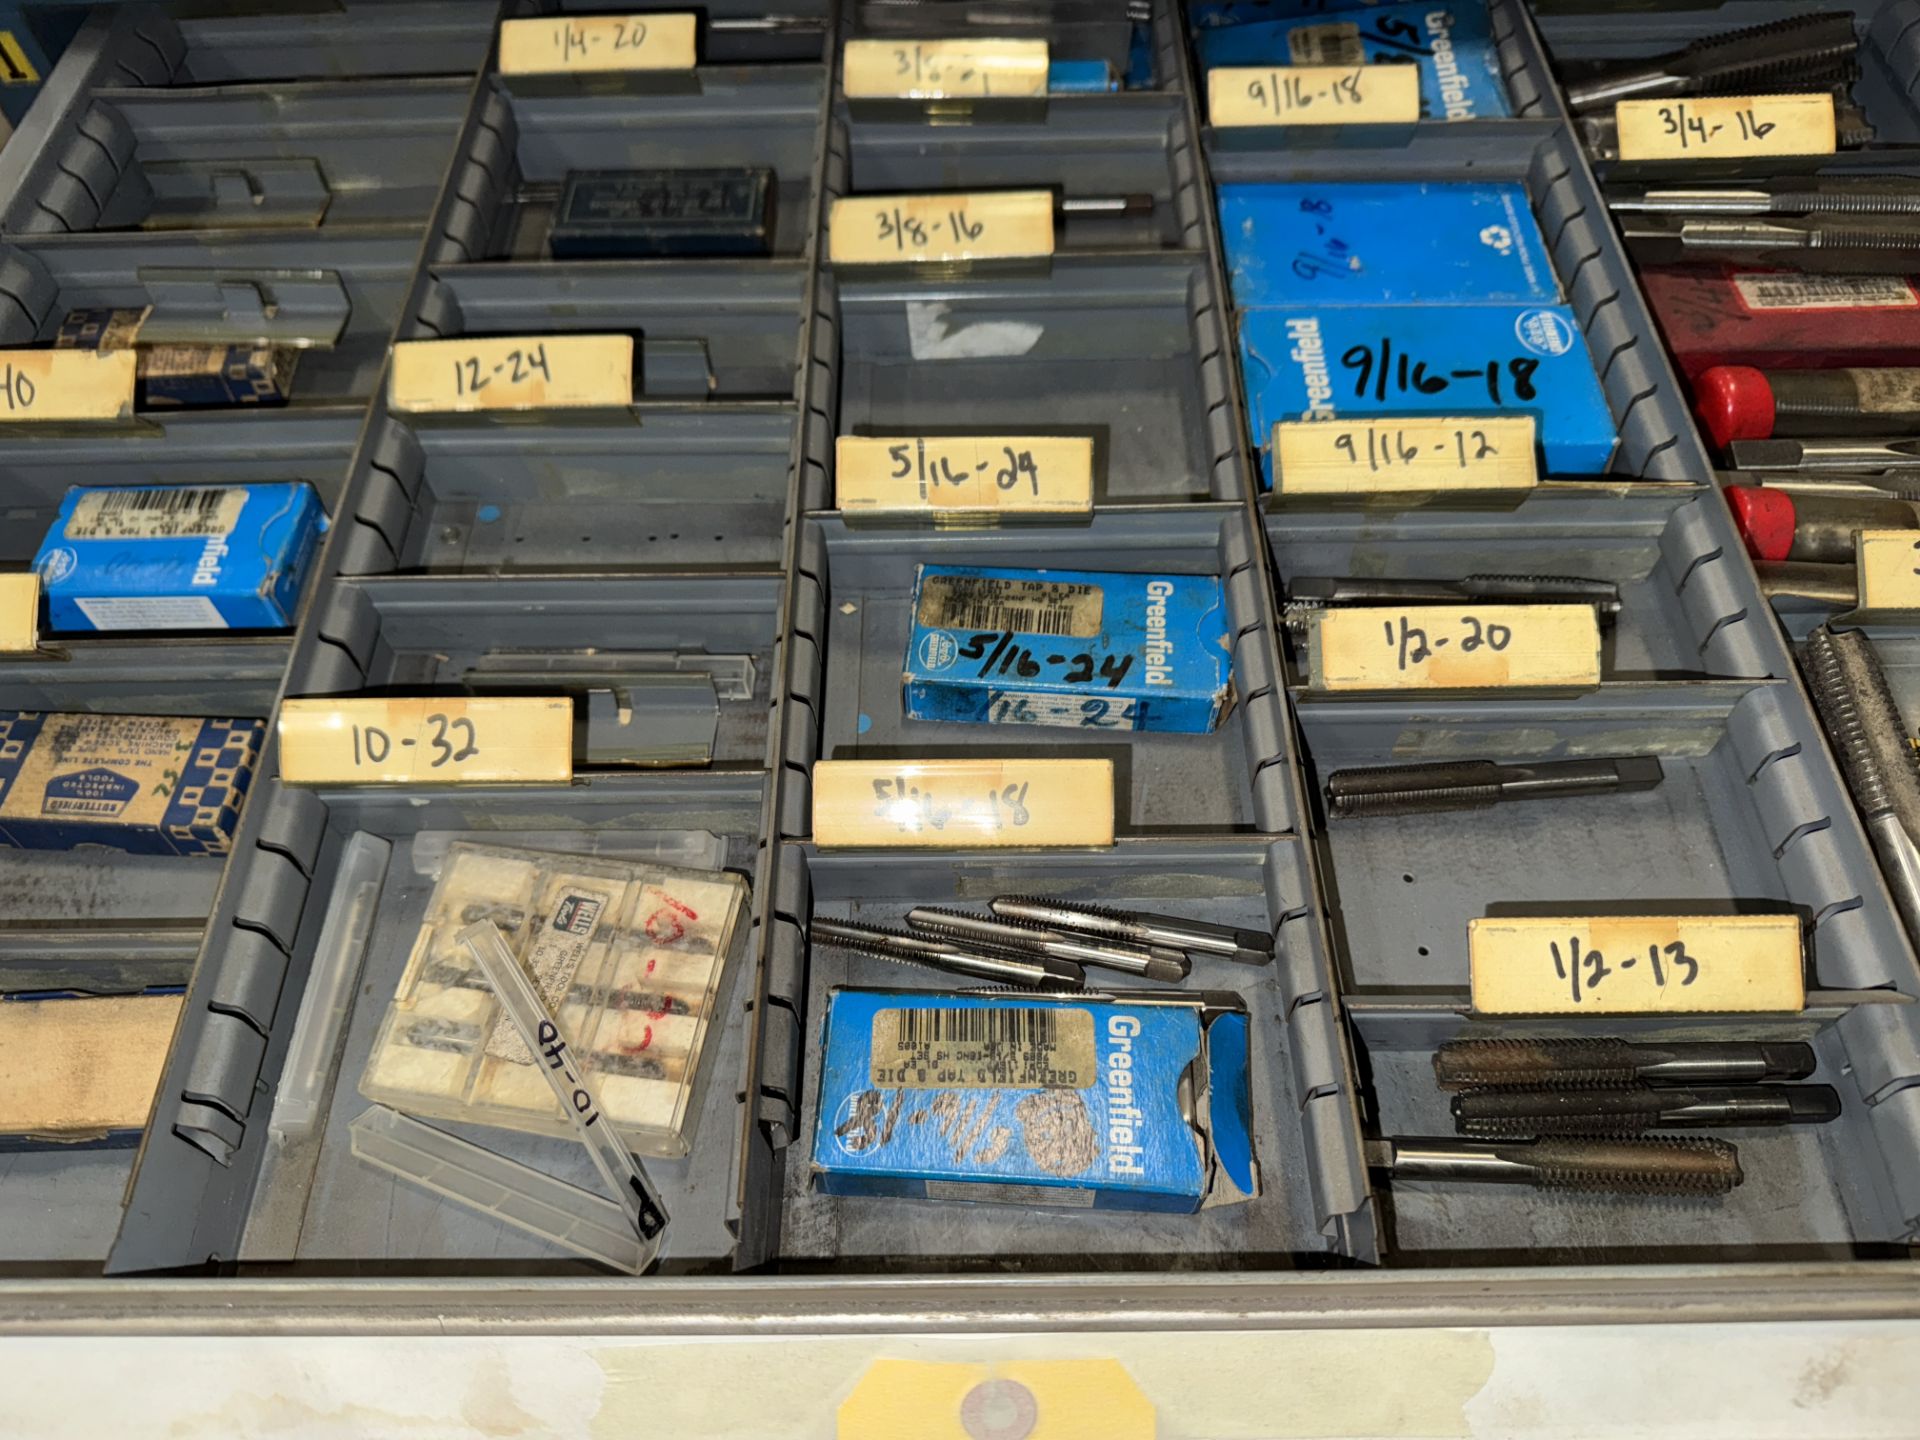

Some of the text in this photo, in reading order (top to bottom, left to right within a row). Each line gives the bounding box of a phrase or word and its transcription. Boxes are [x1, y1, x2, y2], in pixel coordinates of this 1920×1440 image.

[1426, 11, 1476, 122] Greenfield
[1249, 69, 1363, 115] 9/16-18
[876, 208, 983, 249] 3/8-16
[455, 344, 551, 395] 12-24
[1341, 338, 1539, 405] 9/16-18
[1335, 428, 1499, 471] 9/16-12
[889, 438, 1039, 499] 5/16-24
[932, 577, 1011, 589] GREENFIELD
[1021, 582, 1043, 591] TAP
[1068, 585, 1092, 595] DIE
[1145, 581, 1175, 686] Greenfield
[1385, 616, 1511, 671] 1/2-20
[959, 631, 1134, 690] 5/16-24
[354, 714, 479, 767] 10-32
[79, 774, 115, 782] TOOLS
[82, 758, 130, 766] COMPLETE
[135, 759, 152, 767] THE
[62, 781, 125, 790] INSPECTED
[76, 789, 105, 798] 100%
[50, 800, 117, 812] BUTTERFIELD
[556, 900, 575, 925] Tools
[570, 902, 598, 936] WELLS
[566, 942, 584, 970] WELLS
[1550, 937, 1699, 1002] 1/2-13
[554, 971, 571, 994] TOOL
[877, 1069, 906, 1083] DIE
[937, 1069, 965, 1083] TAP
[977, 1068, 1077, 1084] GREENFIELD
[1108, 1014, 1144, 1178] Greenfield
